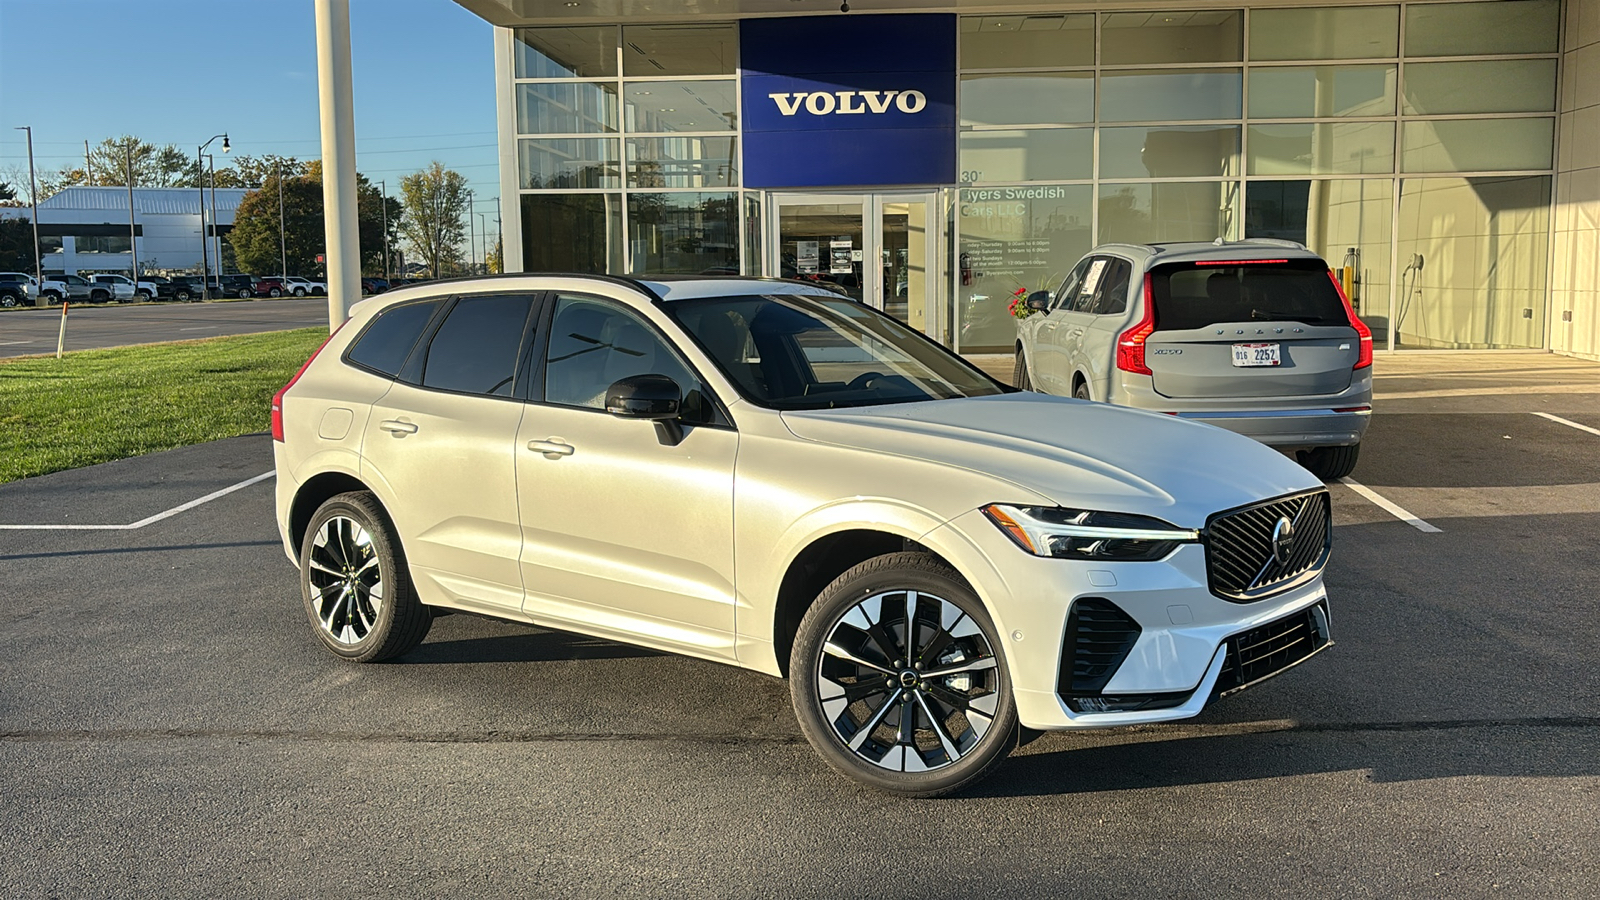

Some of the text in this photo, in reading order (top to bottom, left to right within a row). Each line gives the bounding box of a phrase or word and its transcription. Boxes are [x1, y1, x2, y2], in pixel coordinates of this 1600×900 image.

[768, 90, 927, 116] VOLVO
[1005, 186, 1065, 200] Swedish
[960, 203, 1026, 217] Cars LLC
[1216, 327, 1304, 335] VOLVO
[1235, 349, 1275, 360] 016 2252
